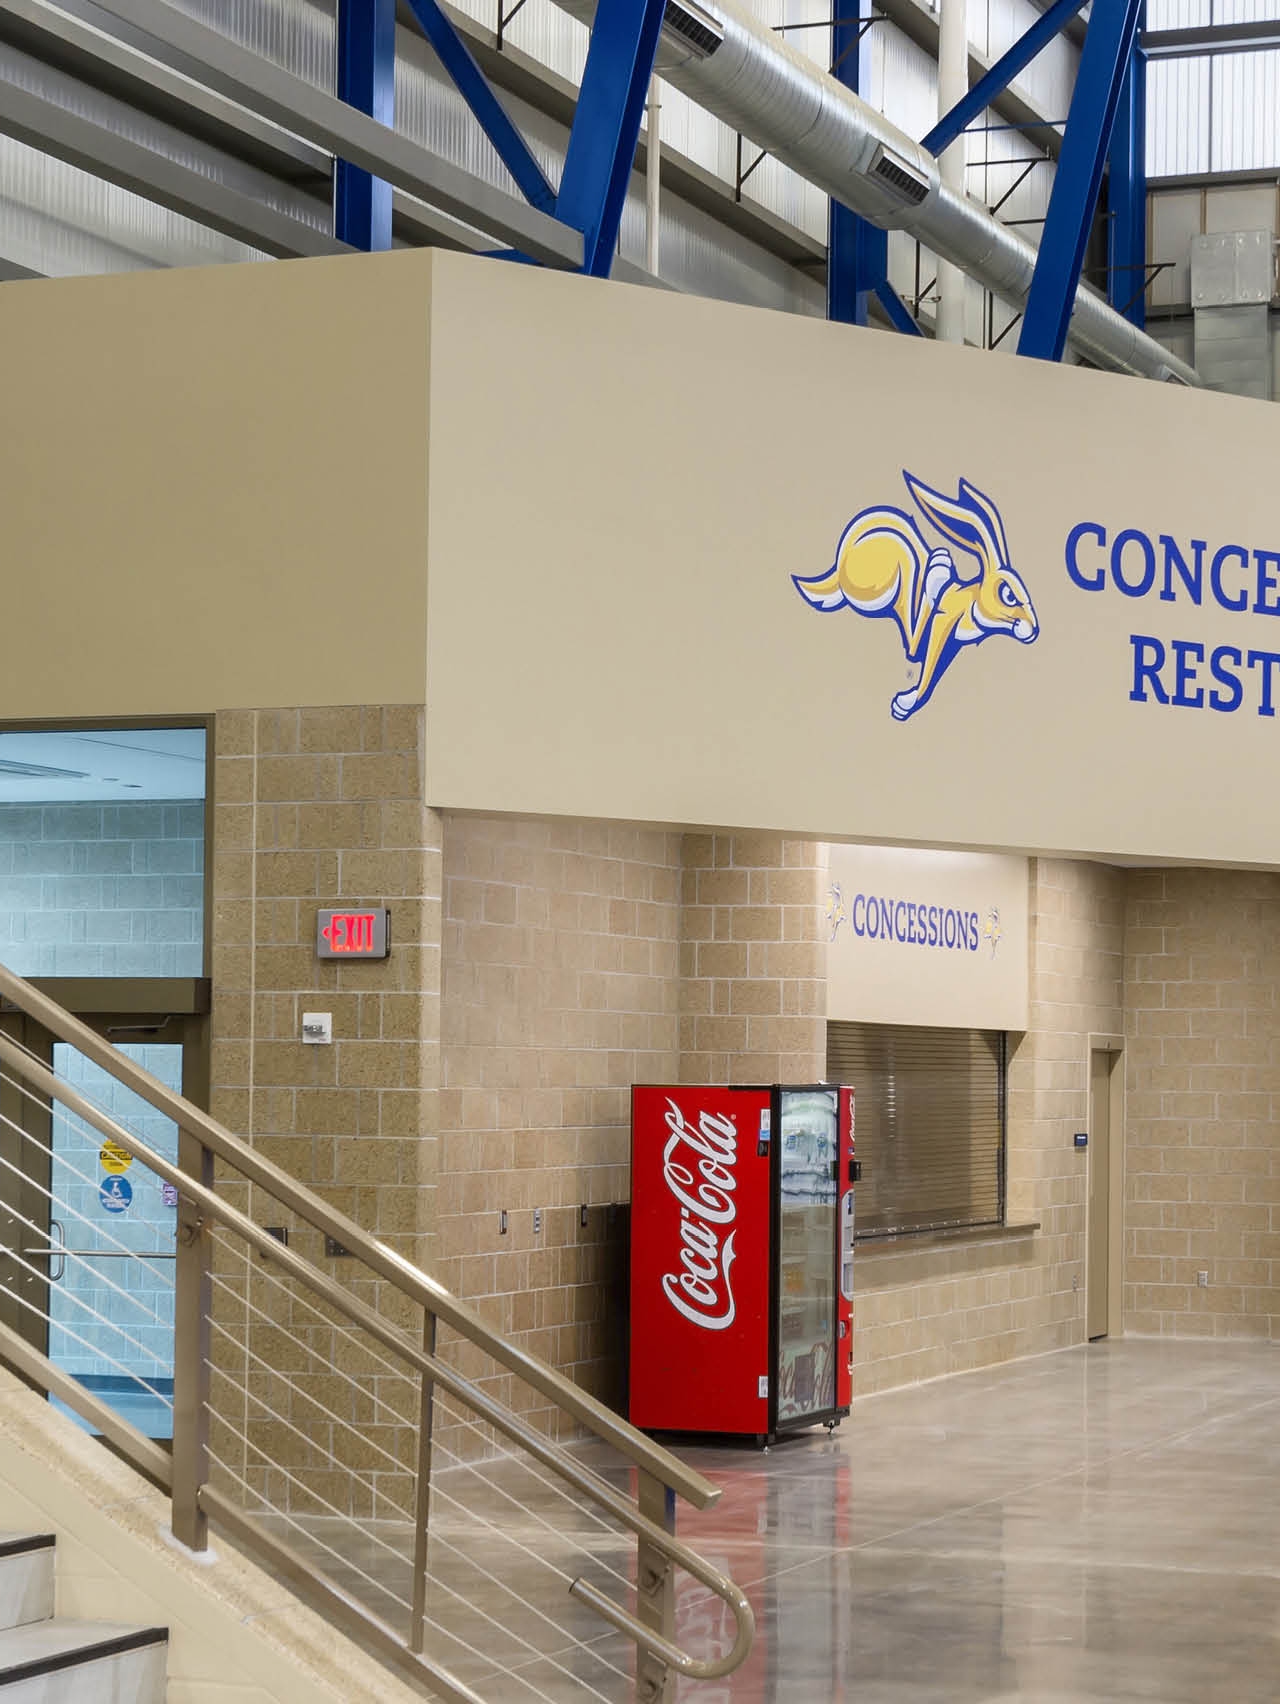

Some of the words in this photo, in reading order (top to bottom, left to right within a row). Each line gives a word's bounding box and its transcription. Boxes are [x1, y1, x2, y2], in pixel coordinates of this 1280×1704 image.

[330, 914, 376, 953] EXIT
[853, 893, 979, 951] CONCESSIONS
[662, 1096, 737, 1330] Coca-Cola
